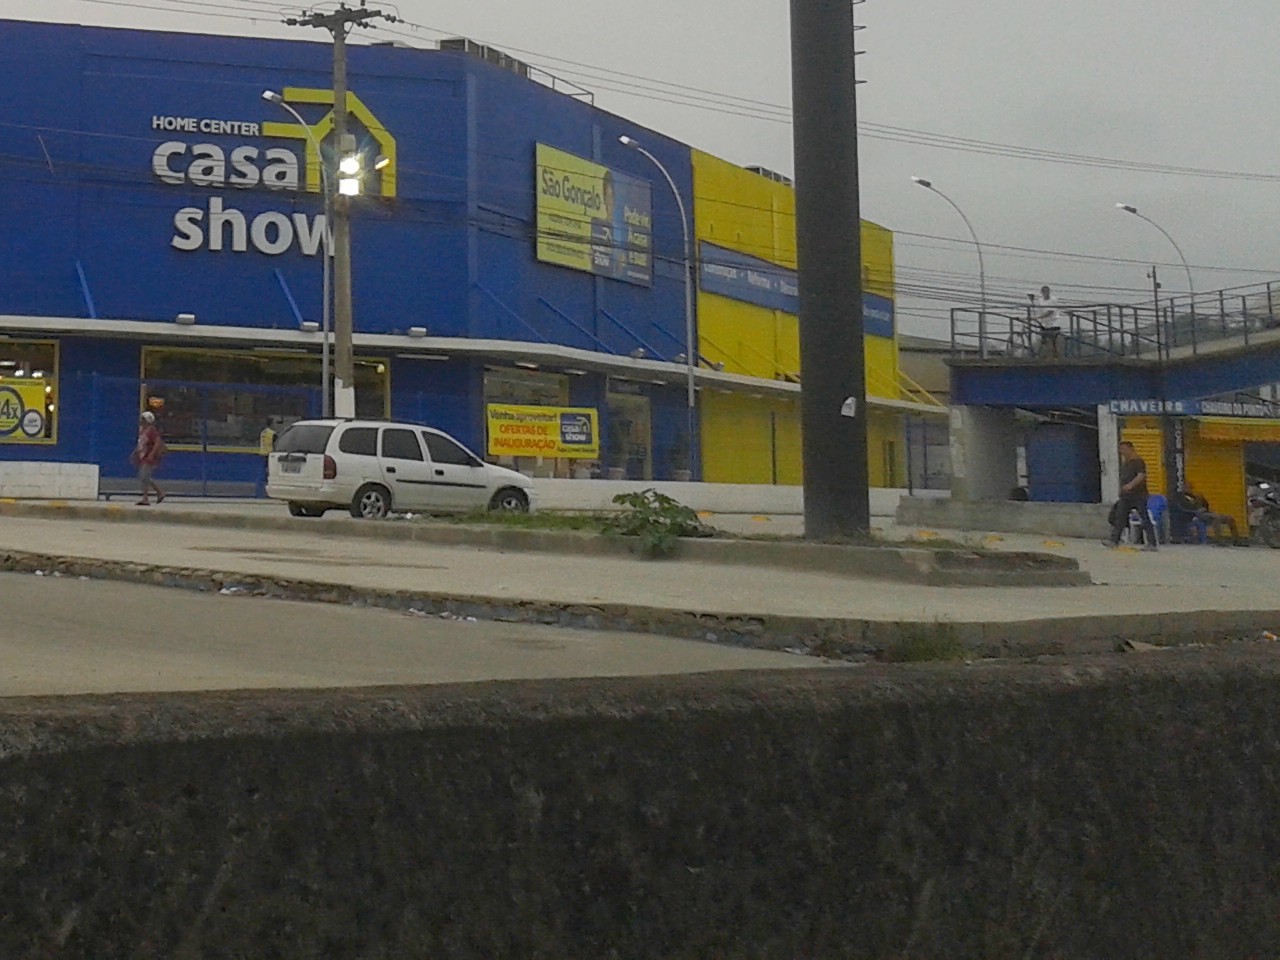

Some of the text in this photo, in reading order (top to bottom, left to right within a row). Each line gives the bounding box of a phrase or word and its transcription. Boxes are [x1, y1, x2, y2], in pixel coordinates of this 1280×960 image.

[152, 115, 260, 136] HOME CENTER
[151, 141, 299, 191] casa
[541, 168, 601, 217] São Gonçalo
[1110, 399, 1184, 413] CHAVEIRO
[499, 424, 549, 436] OFERTAS DE
[494, 437, 556, 453] INAUGURAÇÃO
